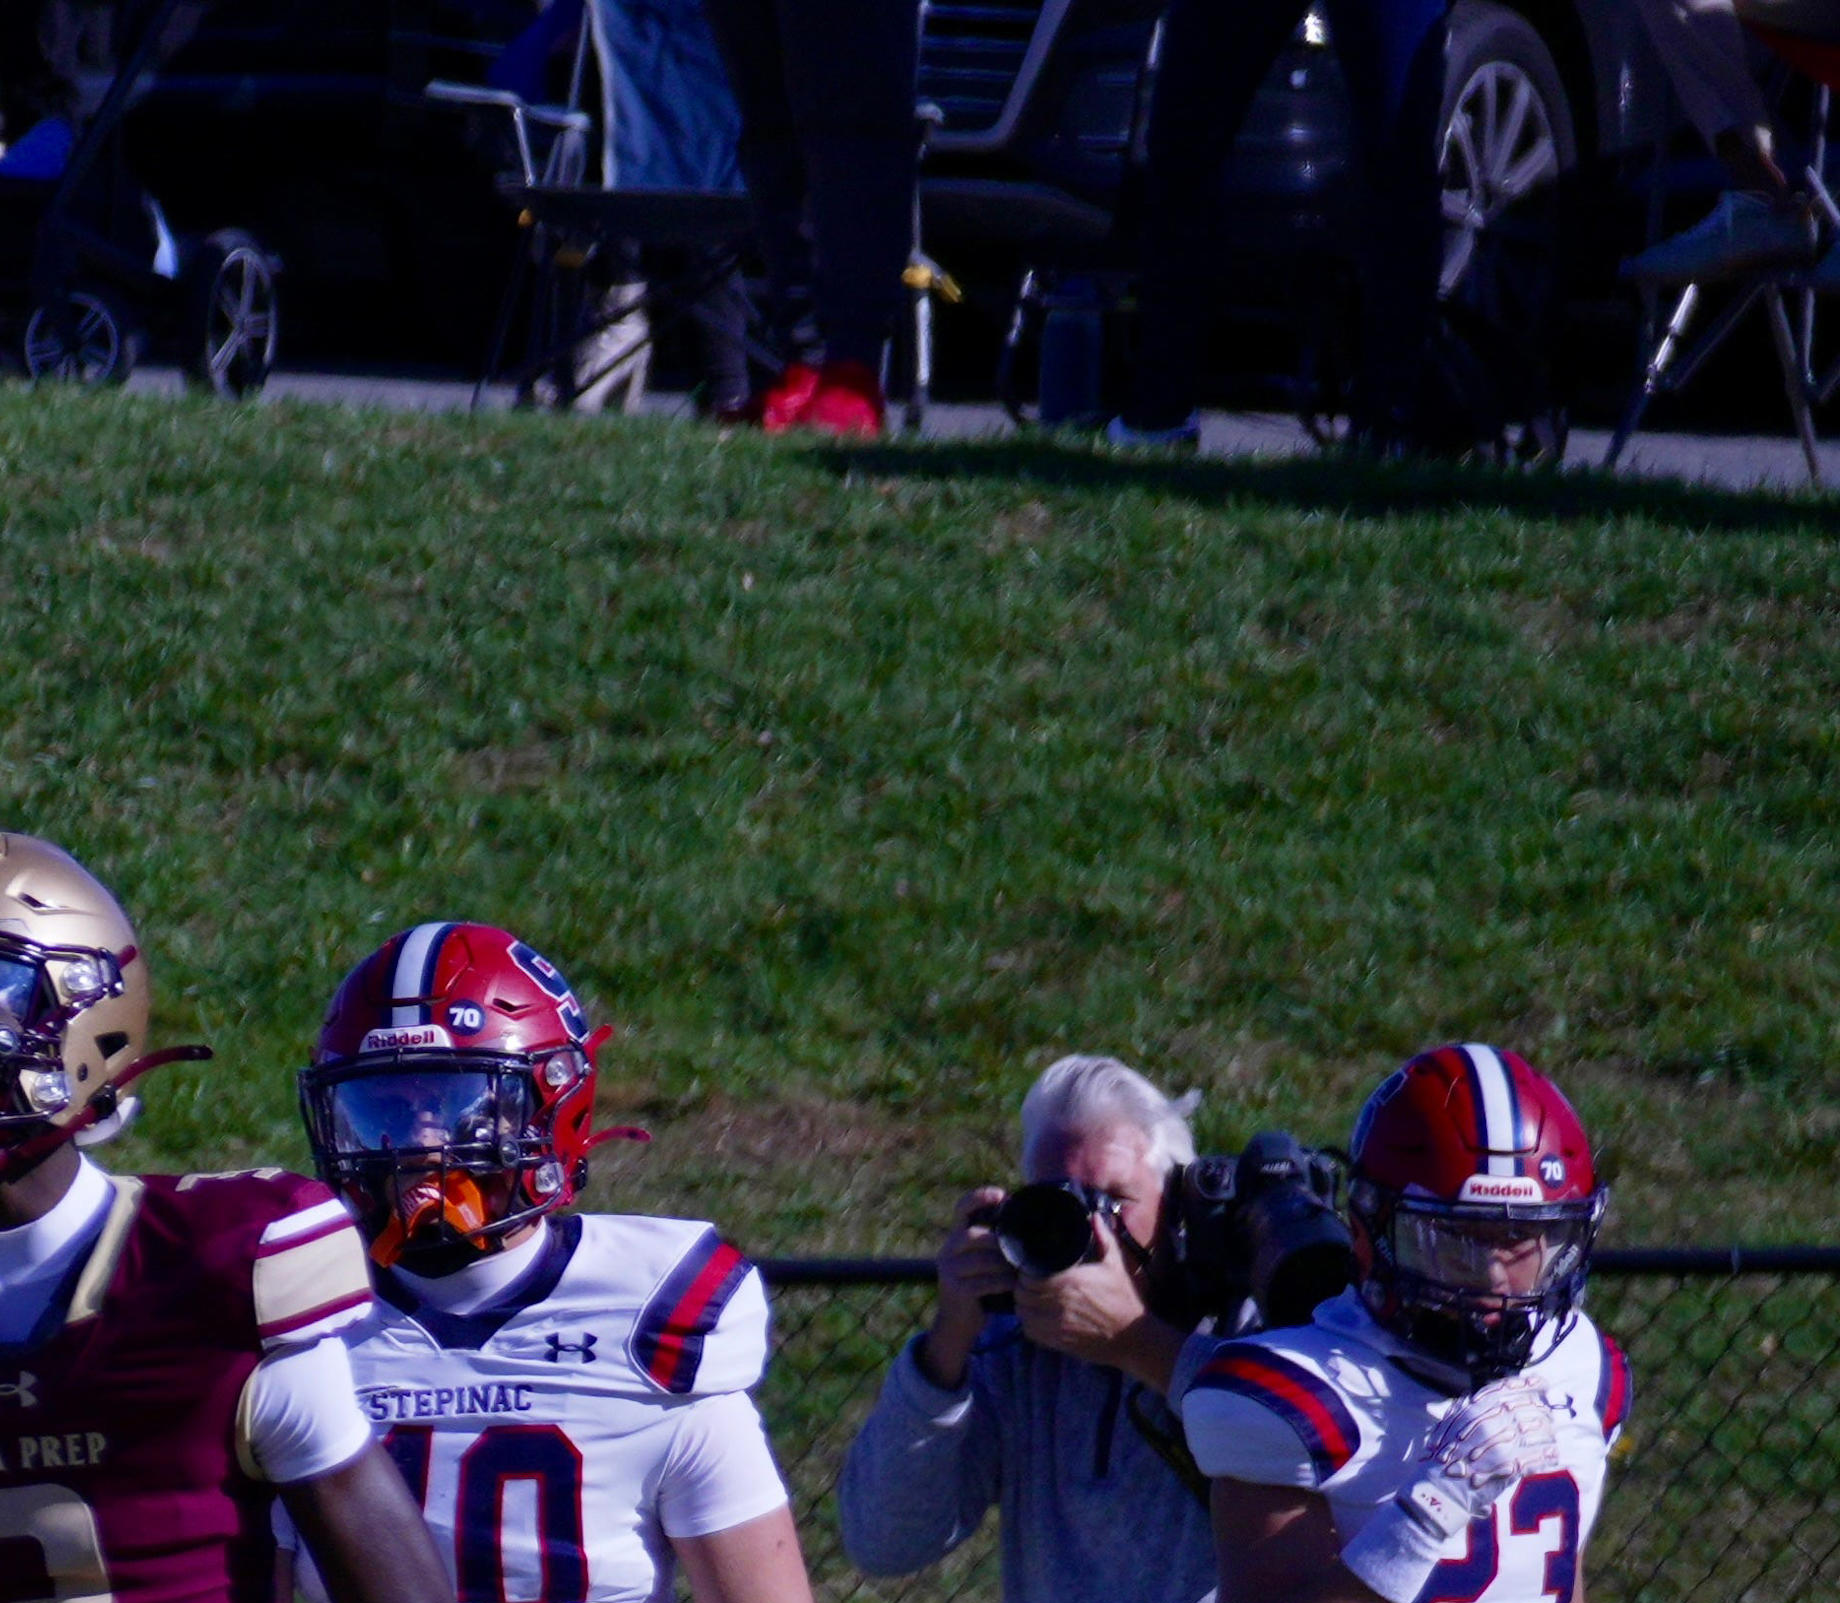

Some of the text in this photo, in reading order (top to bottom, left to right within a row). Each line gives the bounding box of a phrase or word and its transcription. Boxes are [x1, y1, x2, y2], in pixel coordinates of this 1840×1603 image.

[449, 1007, 480, 1027] 70
[368, 1031, 435, 1049] Riddell
[1540, 1161, 1563, 1181] 70
[1469, 1183, 1534, 1197] Riddell
[368, 1384, 534, 1421] STEPINAC
[18, 1432, 107, 1469] PREP
